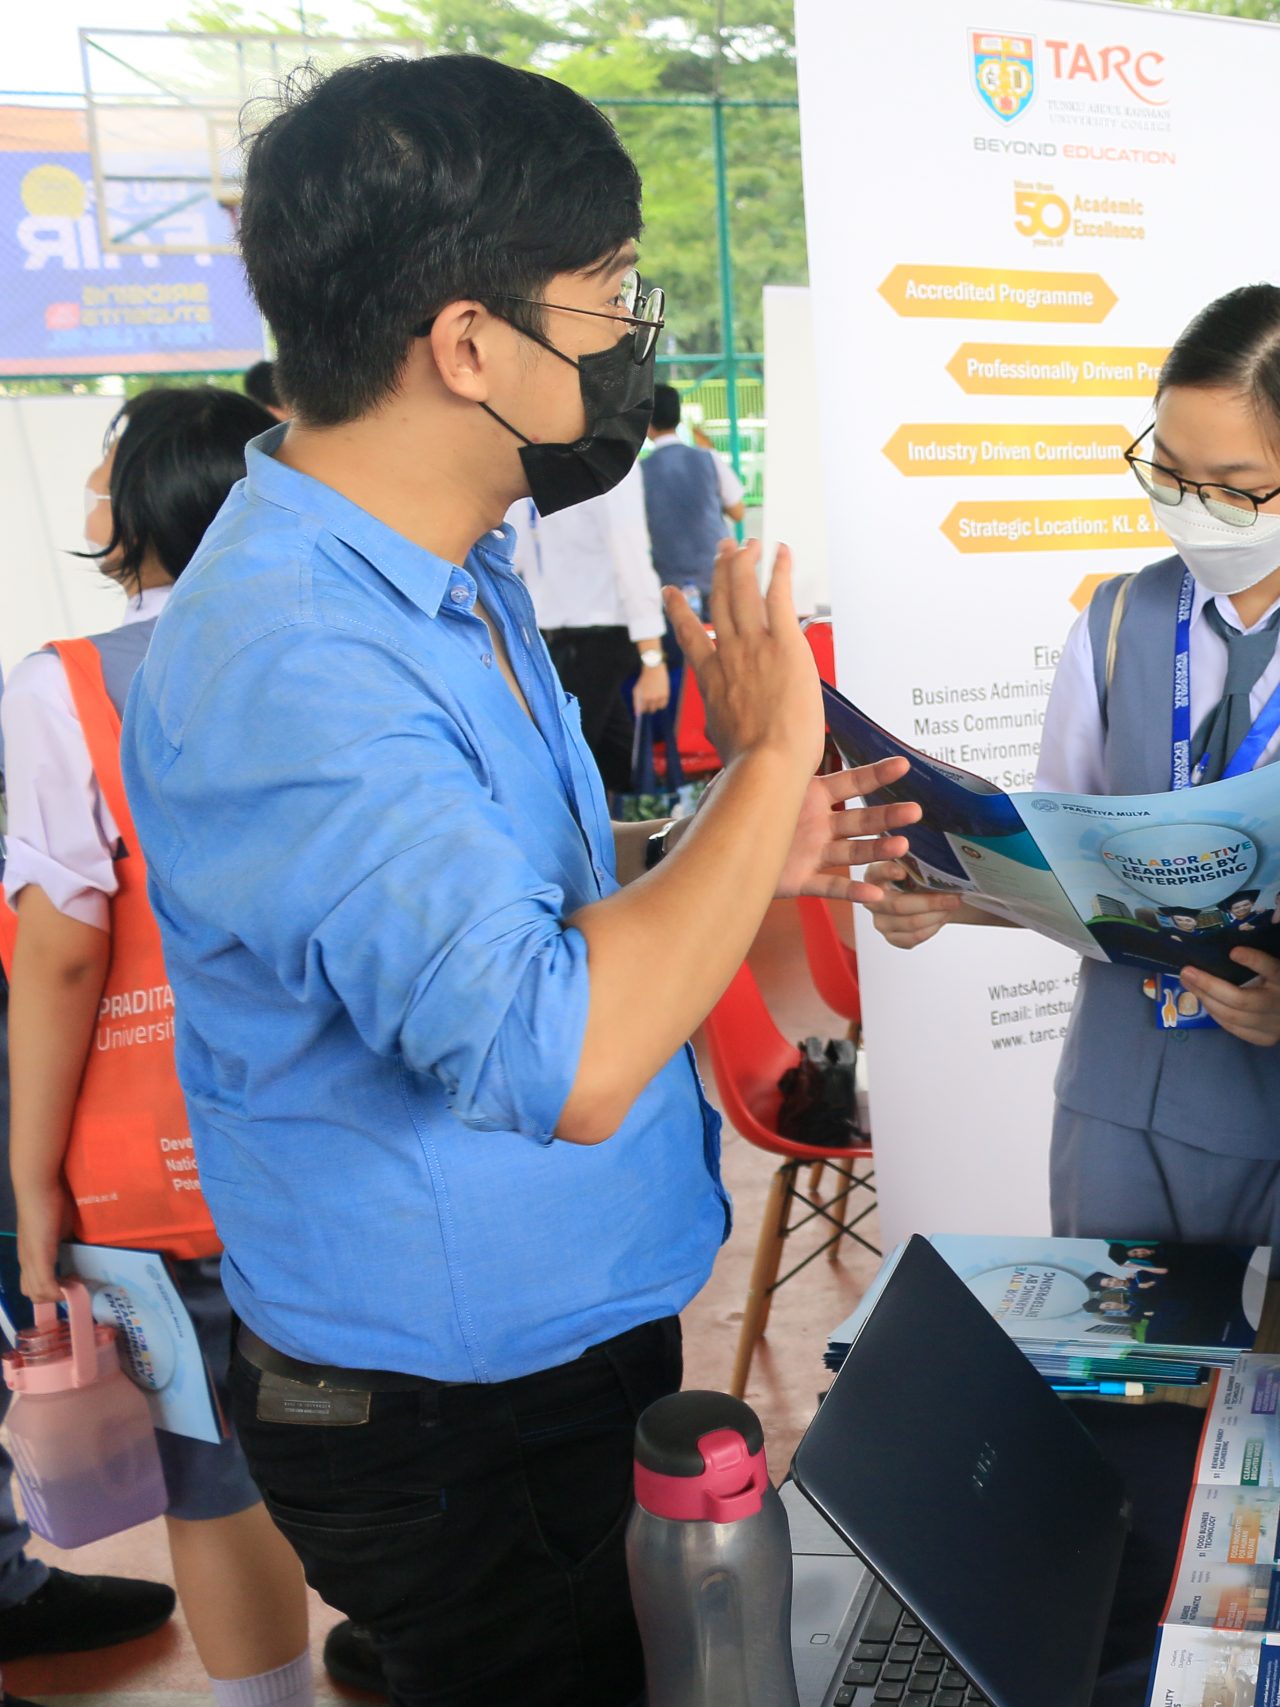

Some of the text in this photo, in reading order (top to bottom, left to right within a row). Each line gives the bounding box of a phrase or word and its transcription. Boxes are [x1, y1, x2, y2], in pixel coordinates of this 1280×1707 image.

[1045, 39, 1169, 105] TARC
[973, 137, 1176, 165] BEYOND EDUCATION
[1014, 191, 1144, 238] 50 Academic
[1074, 219, 1145, 240] Excellence
[905, 280, 1094, 307] Accredited Programme
[967, 359, 1133, 384] Professionally Driven
[908, 442, 1123, 464] Industry Driven Curriculum
[959, 515, 1149, 541] Strategic Location: KL &
[911, 686, 986, 706] Business
[914, 718, 959, 736] Mass
[1062, 806, 1115, 817] PRASETIYA
[1103, 840, 1253, 867] COLLABORATIVE
[1120, 863, 1249, 886] ENTERPRISING
[1122, 855, 1239, 877] LEARNING BY
[988, 979, 1061, 1000] WhatsApp:
[99, 984, 175, 1022] PRADITA
[991, 1005, 1033, 1026] Email:
[1025, 1274, 1040, 1285] BY
[1025, 1272, 1056, 1318] ENTERPRISING
[114, 1297, 142, 1358] LEARNING
[1243, 1458, 1252, 1480] CLEANER
[1250, 1456, 1259, 1481] BRIGHTER
[1200, 1511, 1210, 1534] BUSINESS
[1204, 1516, 1216, 1549] TECHNOLOGY
[1197, 1534, 1206, 1549] FOOD
